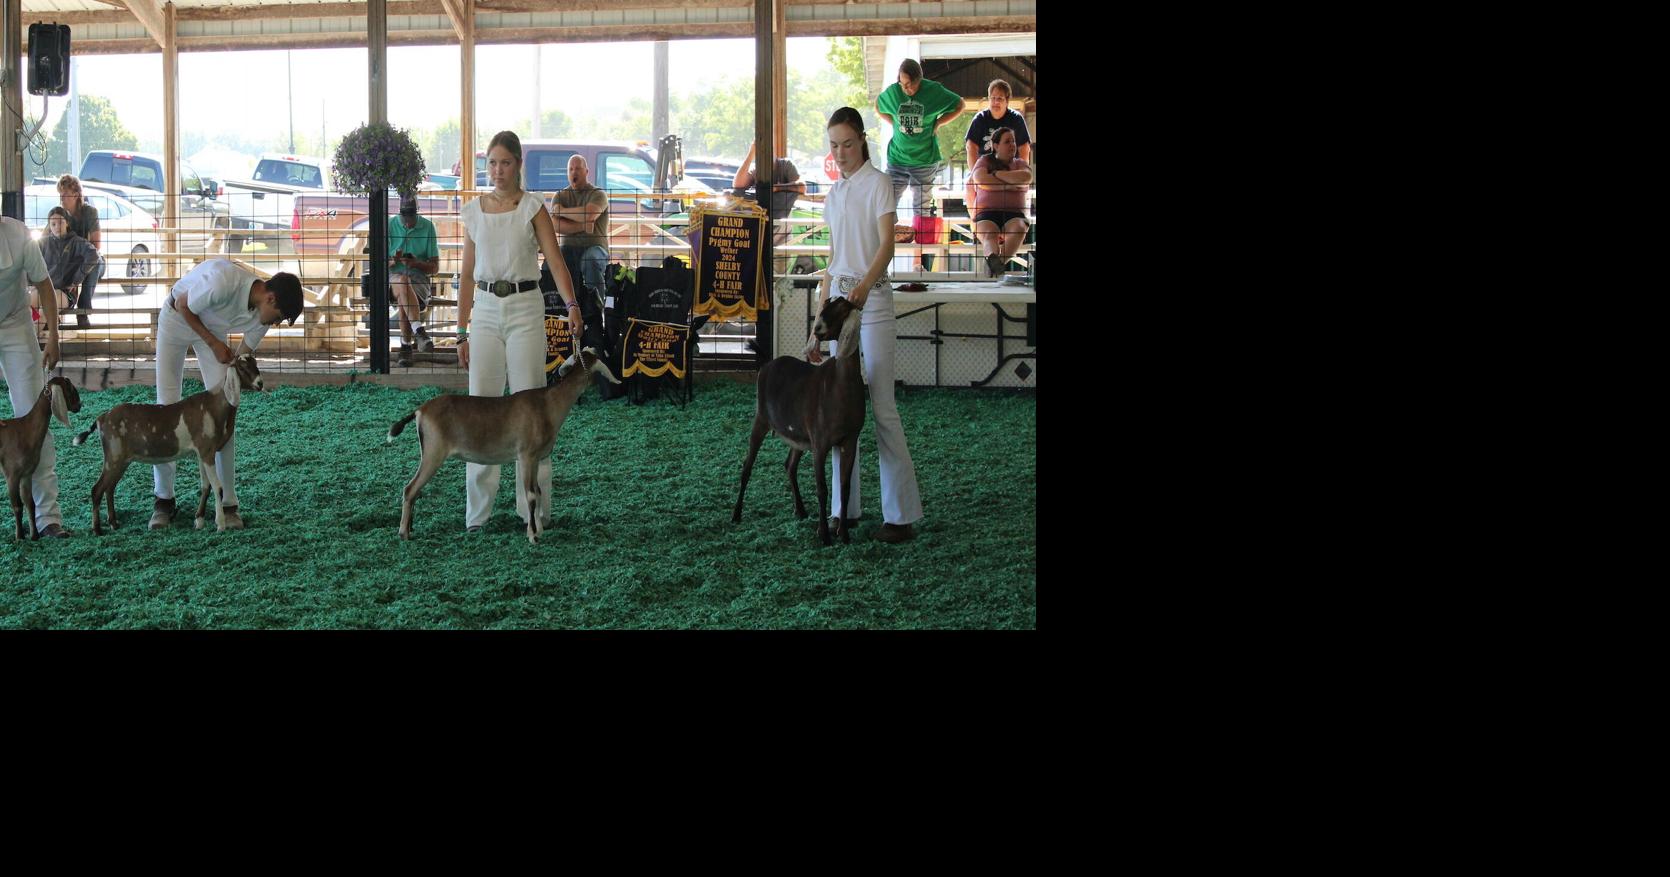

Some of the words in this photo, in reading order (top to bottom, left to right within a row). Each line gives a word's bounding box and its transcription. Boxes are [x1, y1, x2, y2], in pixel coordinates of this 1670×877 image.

[717, 217, 744, 228] GRAND
[710, 227, 750, 239] CHAMPION
[708, 237, 732, 248] Pygmy
[733, 239, 751, 249] Goat
[715, 261, 742, 272] SHELBY
[715, 271, 741, 281] COUNTY
[726, 280, 743, 290] FAIR
[653, 341, 670, 350] FAIR
